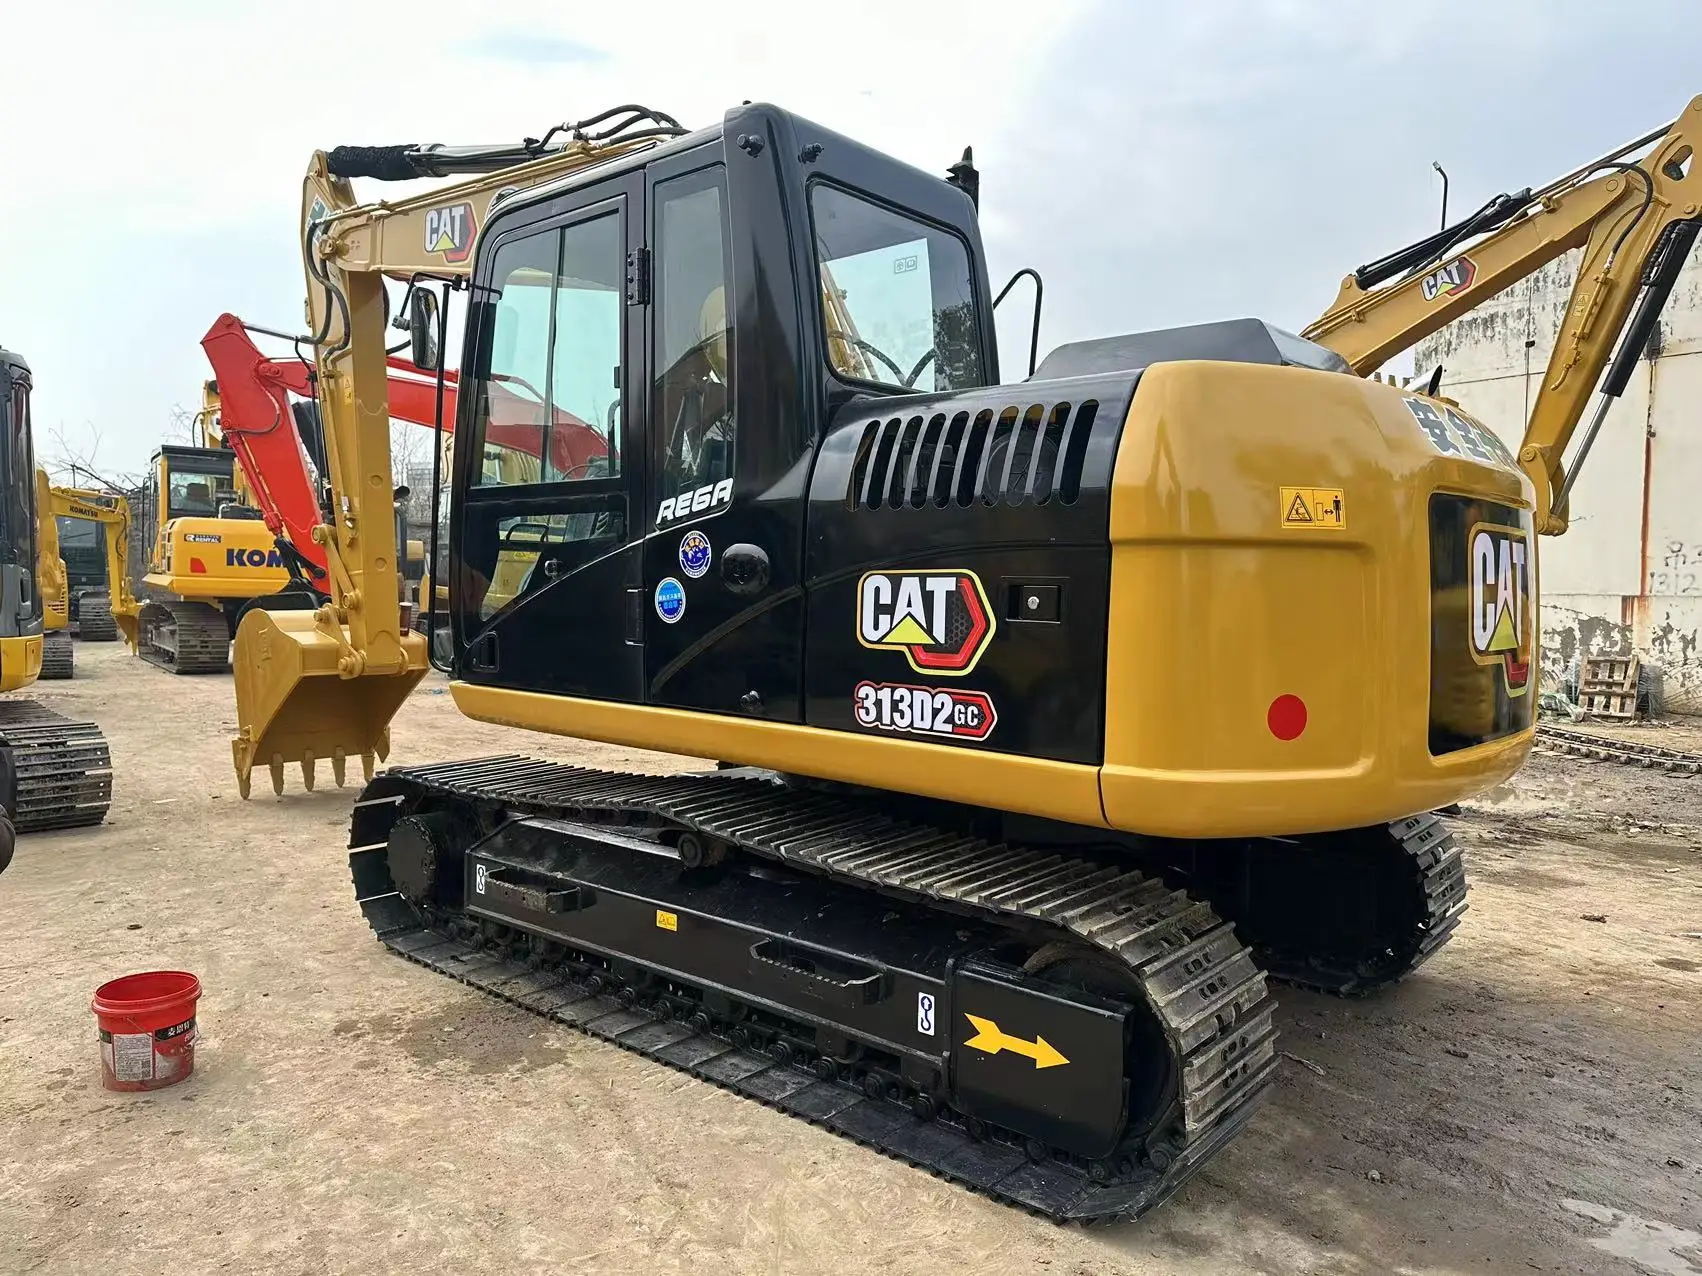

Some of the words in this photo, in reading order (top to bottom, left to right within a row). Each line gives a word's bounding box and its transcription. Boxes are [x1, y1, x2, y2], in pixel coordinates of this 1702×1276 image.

[425, 206, 465, 252] CAT
[1421, 260, 1461, 301] CAT
[69, 504, 98, 518] KOMATSU
[655, 477, 734, 525] REGA
[226, 548, 288, 568] KOM
[862, 574, 957, 645] CAT
[1473, 532, 1525, 651] CAT
[857, 685, 954, 733] 313D2
[953, 704, 979, 727] GC
